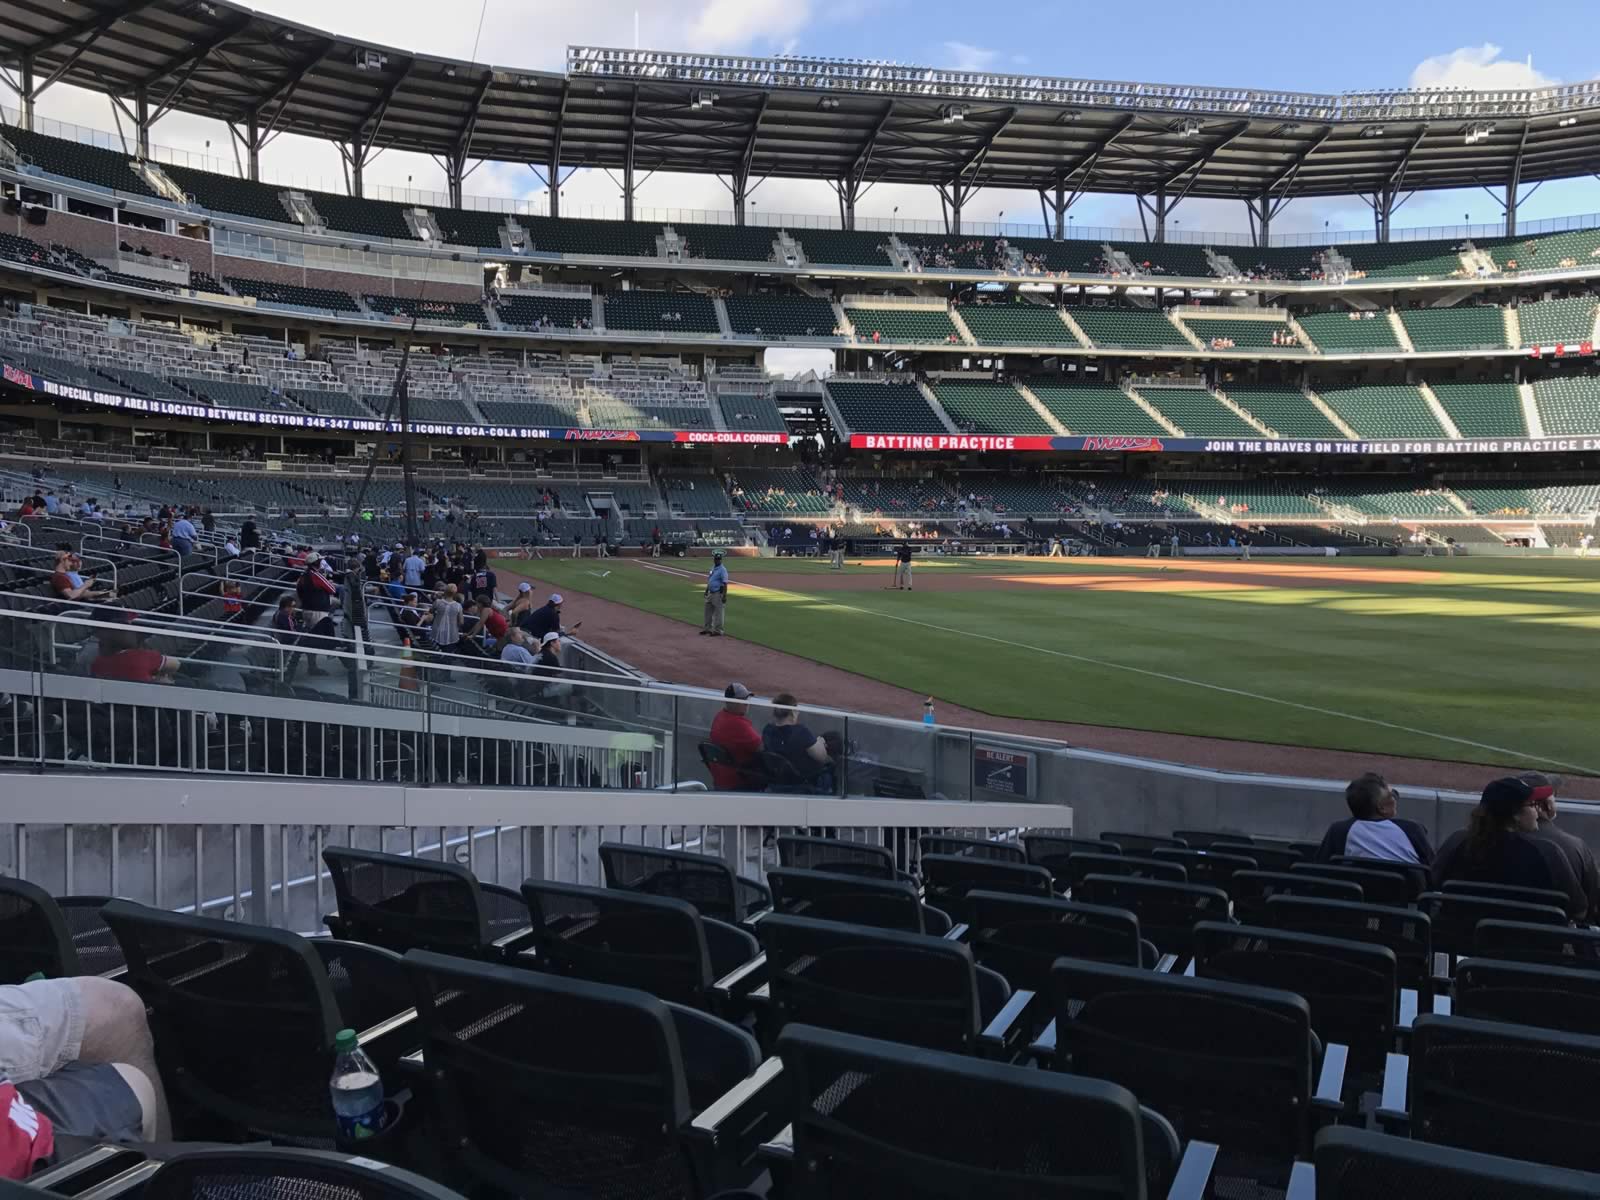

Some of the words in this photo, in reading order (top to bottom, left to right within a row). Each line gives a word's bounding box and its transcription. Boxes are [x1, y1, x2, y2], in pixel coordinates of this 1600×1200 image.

[43, 380, 59, 395] THIS
[59, 385, 93, 402] SPECIAL
[93, 392, 122, 407] GROUP
[124, 397, 149, 411] AREA
[150, 401, 160, 412] IS
[161, 402, 206, 418] LOCATED
[207, 408, 256, 422] BETWEEN
[259, 414, 304, 427] SECTION
[306, 418, 349, 429] 345-347
[416, 424, 453, 435] ICONIC
[456, 426, 518, 438] COCA-COLA
[520, 429, 550, 439] SIGN!
[688, 432, 742, 443] COCA-COLA
[743, 434, 781, 444] CORNER
[866, 436, 933, 449] BATTING
[939, 437, 1015, 449] PRACTICE
[1205, 441, 1235, 452] JOIN
[1238, 442, 1261, 452] THE
[1265, 442, 1312, 453] BRAVES
[1315, 443, 1332, 453] ON
[1335, 443, 1359, 453] THE
[1361, 443, 1400, 453] FIELD
[1405, 443, 1432, 452] FOR
[1437, 442, 1498, 452] BATTING
[1503, 440, 1578, 452] PRACTICE
